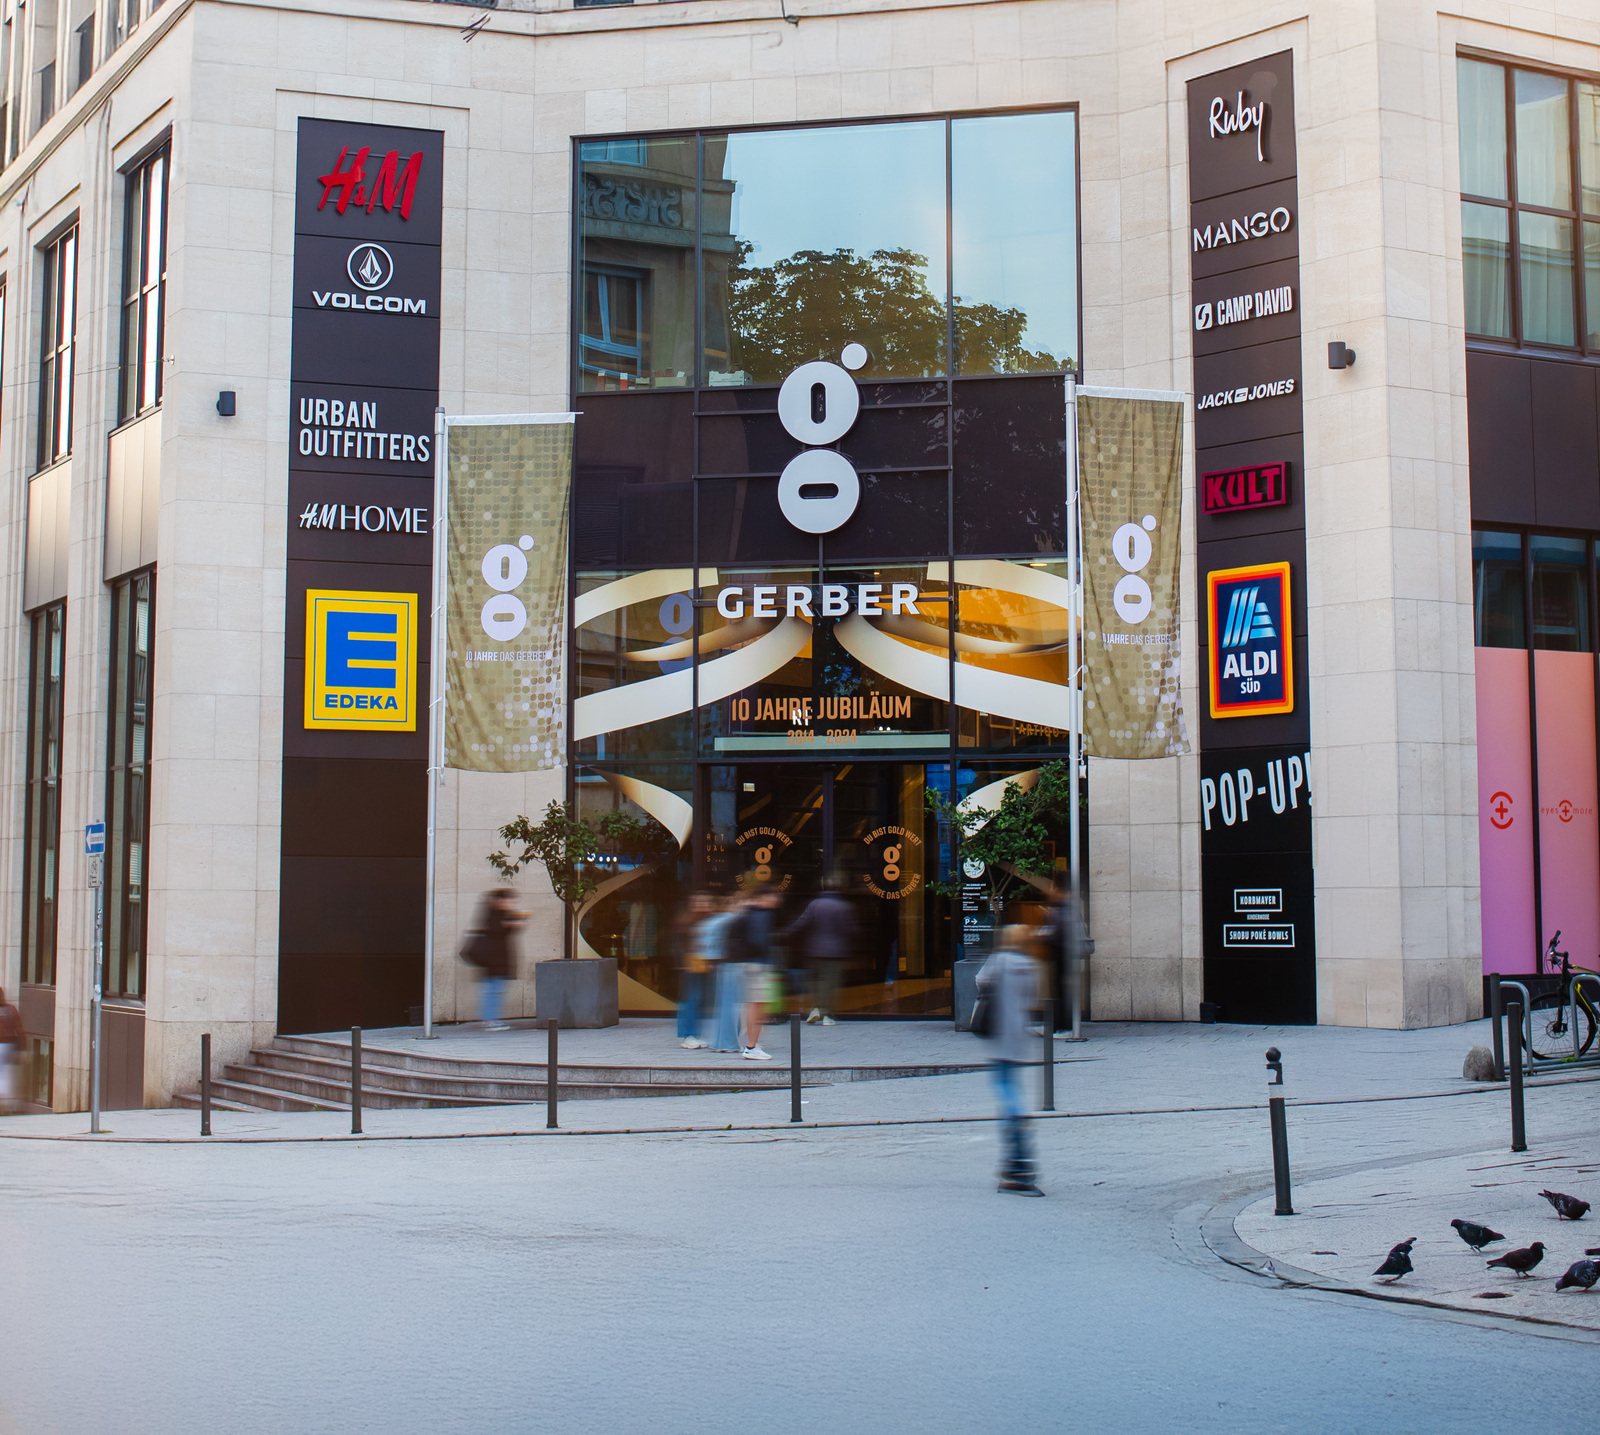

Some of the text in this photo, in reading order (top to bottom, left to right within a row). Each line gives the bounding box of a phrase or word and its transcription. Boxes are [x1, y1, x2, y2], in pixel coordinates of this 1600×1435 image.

[1209, 90, 1264, 162] Ruby
[318, 145, 424, 221] H&M
[1193, 206, 1291, 252] MANGO
[312, 290, 426, 314] VOLCOM
[1217, 285, 1292, 326] CAMP DAVID
[1197, 378, 1295, 410] JACK JONES
[300, 398, 377, 429] URBAN
[299, 428, 430, 462] OUTFITTERS
[1206, 467, 1281, 509] KULT
[299, 502, 428, 534] H&M HOME
[717, 583, 921, 618] GERBER
[1107, 633, 1129, 644] JAHRE
[1130, 634, 1144, 645] DAS
[466, 650, 473, 661] 10
[473, 650, 498, 661] JAHRE
[500, 650, 515, 661] DAS
[1223, 650, 1278, 679] ALDI
[1240, 678, 1261, 694] SÜD
[325, 694, 398, 710] EDEKA
[731, 691, 911, 721] 10 JAHRE JUBILÄUM
[787, 729, 815, 745] 2014
[826, 728, 857, 744] 2024
[1540, 807, 1593, 816] eyes more
[735, 826, 794, 847] DU BIST GOLD WERT
[863, 825, 922, 847] DU BIST GOLD WERT
[866, 881, 886, 899] JAHRE
[886, 891, 900, 900] DAS
[900, 873, 922, 898] GERBER
[1239, 895, 1276, 905] KORBMAYER
[1229, 928, 1289, 940] SHOBU POKÉ BOWLS
